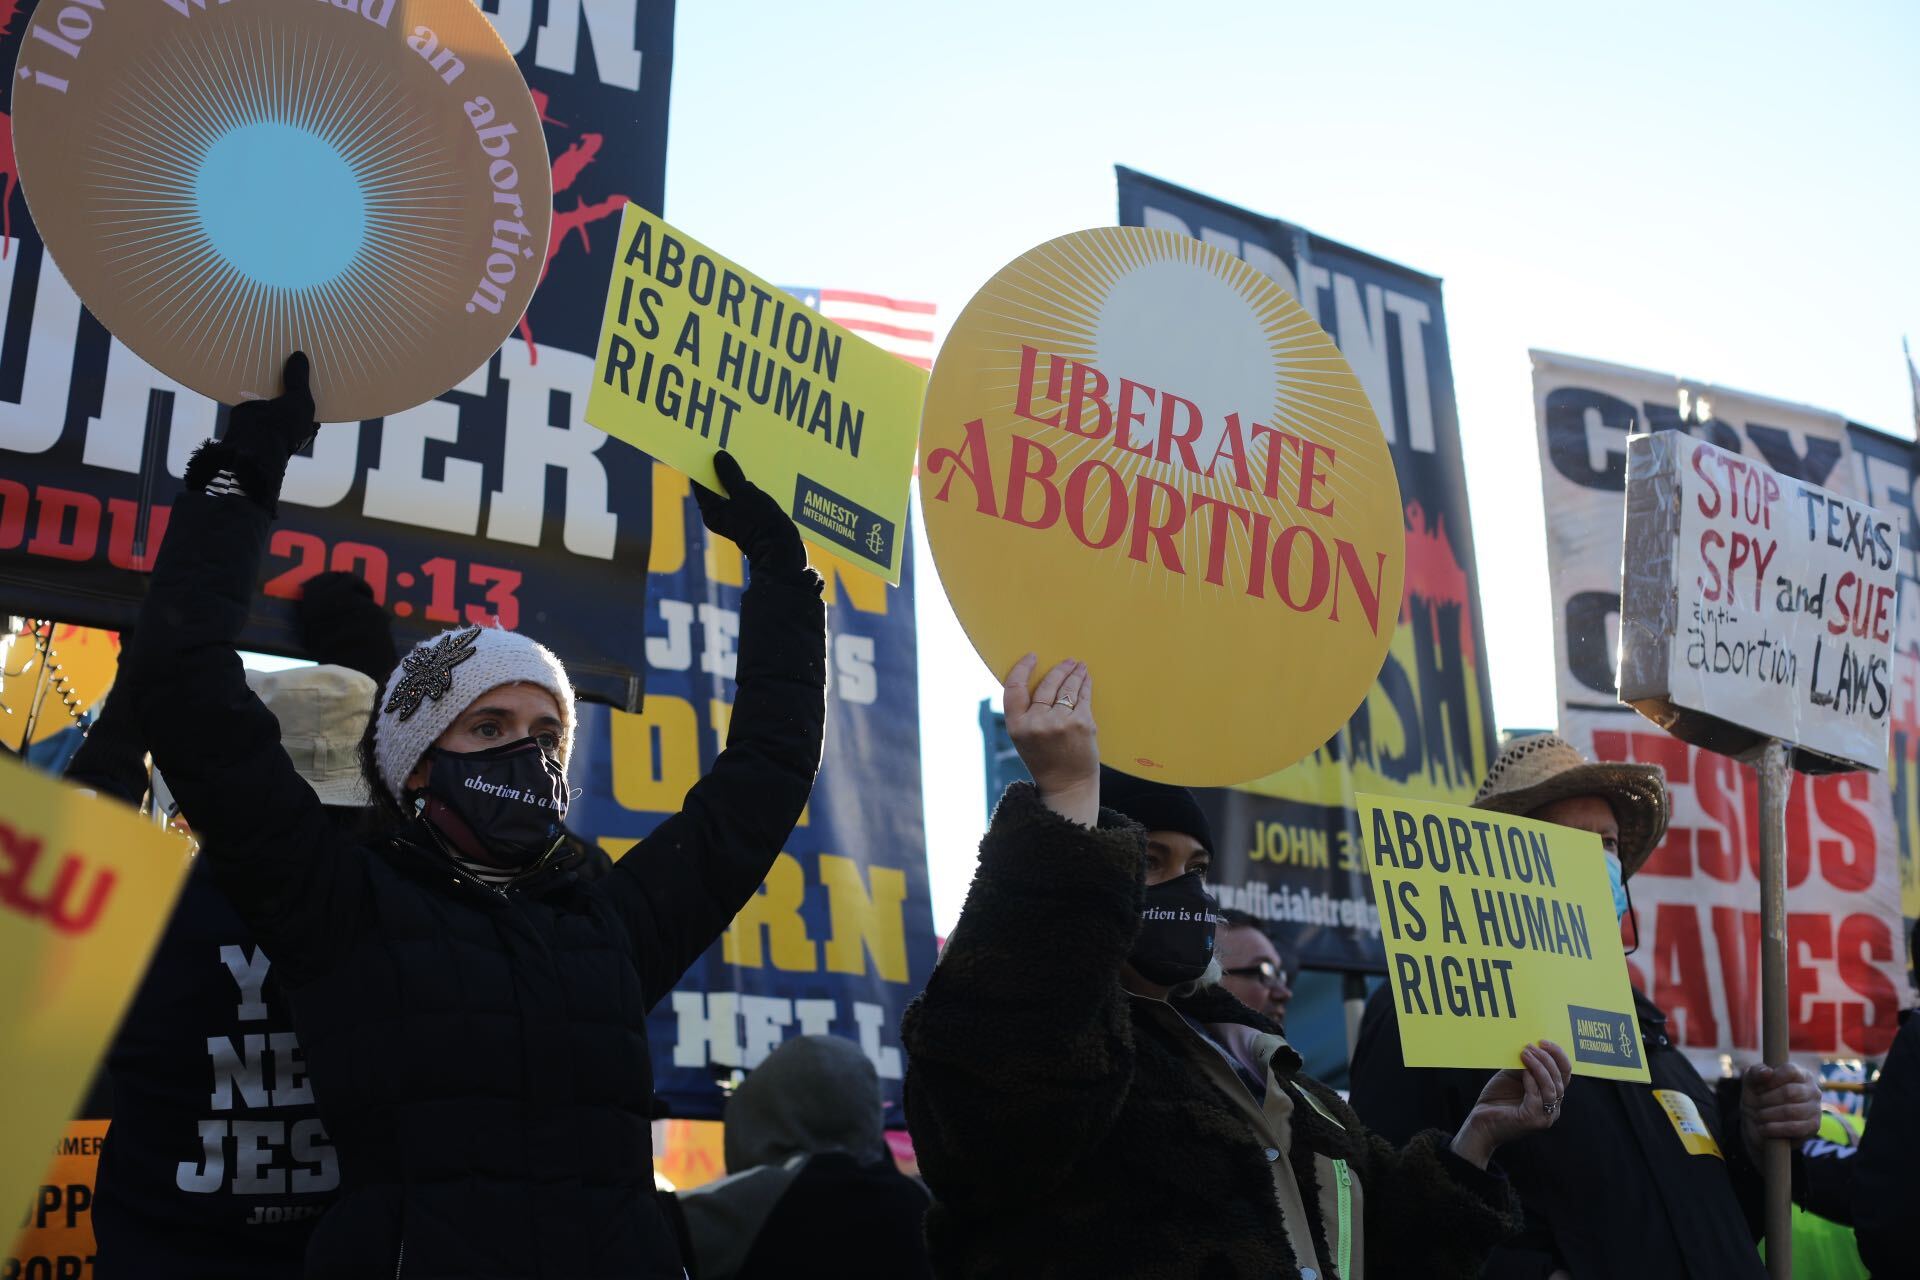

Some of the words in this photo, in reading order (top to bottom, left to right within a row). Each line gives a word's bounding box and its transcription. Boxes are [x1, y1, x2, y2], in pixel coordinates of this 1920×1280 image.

[32, 0, 105, 59] lo
[407, 25, 465, 85] an
[464, 96, 534, 314] abortion.
[624, 220, 842, 384] ABORTION
[603, 333, 742, 450] RIGHT
[617, 276, 664, 341] IS
[673, 311, 700, 367] A
[716, 331, 865, 459] HUMAN
[1013, 344, 1336, 518] LIBERATE
[803, 506, 856, 541] INTERNATIONAL
[804, 490, 859, 529] AMNESTY
[926, 418, 1387, 639] ABORTION
[1691, 442, 1781, 530] STOP
[1797, 487, 1892, 571] TEXAS
[1697, 529, 1778, 612] SPY
[1776, 573, 1827, 619] and
[1827, 571, 1895, 644] SUE
[1687, 619, 1797, 686] abortion
[464, 776, 520, 800] abortion
[523, 788, 536, 804] is
[538, 797, 547, 807] a
[1249, 820, 1331, 869] JOHN
[1372, 807, 1556, 888] ABORTION
[1180, 907, 1191, 921] is
[1194, 912, 1202, 922] a
[1382, 880, 1427, 942] IS
[1439, 885, 1467, 945] A
[1471, 888, 1593, 961] HUMAN
[1395, 953, 1517, 1019] RIGHT
[1577, 1019, 1612, 1041] AMNESTY
[20, 1184, 92, 1229] PP
